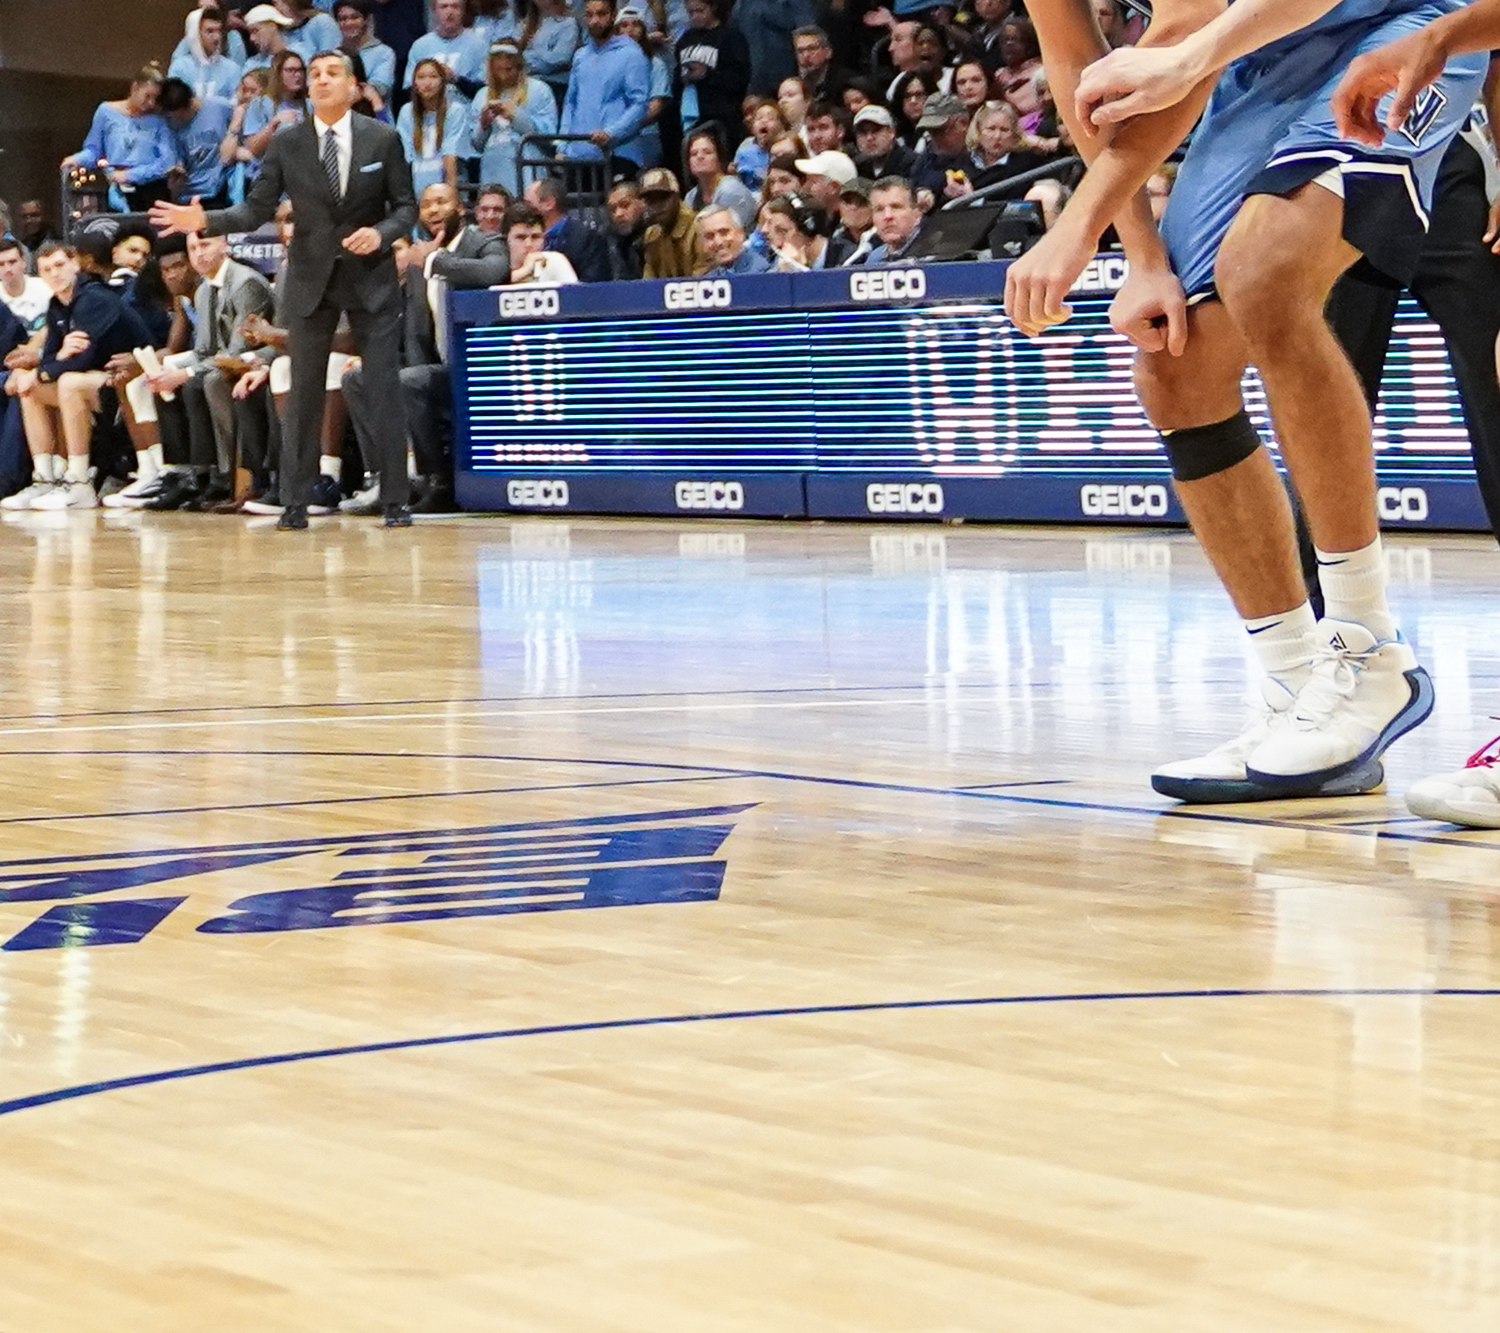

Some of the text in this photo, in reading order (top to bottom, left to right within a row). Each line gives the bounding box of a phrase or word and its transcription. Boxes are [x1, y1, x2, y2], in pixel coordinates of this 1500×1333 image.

[850, 269, 926, 301] GEICO
[1070, 259, 1130, 291] EIC
[499, 289, 560, 317] GEICO
[664, 279, 731, 309] GEICO
[507, 480, 569, 507] GEICO
[675, 481, 744, 509] GEICO
[866, 483, 944, 513] GEICO
[1080, 484, 1168, 516] GEICO
